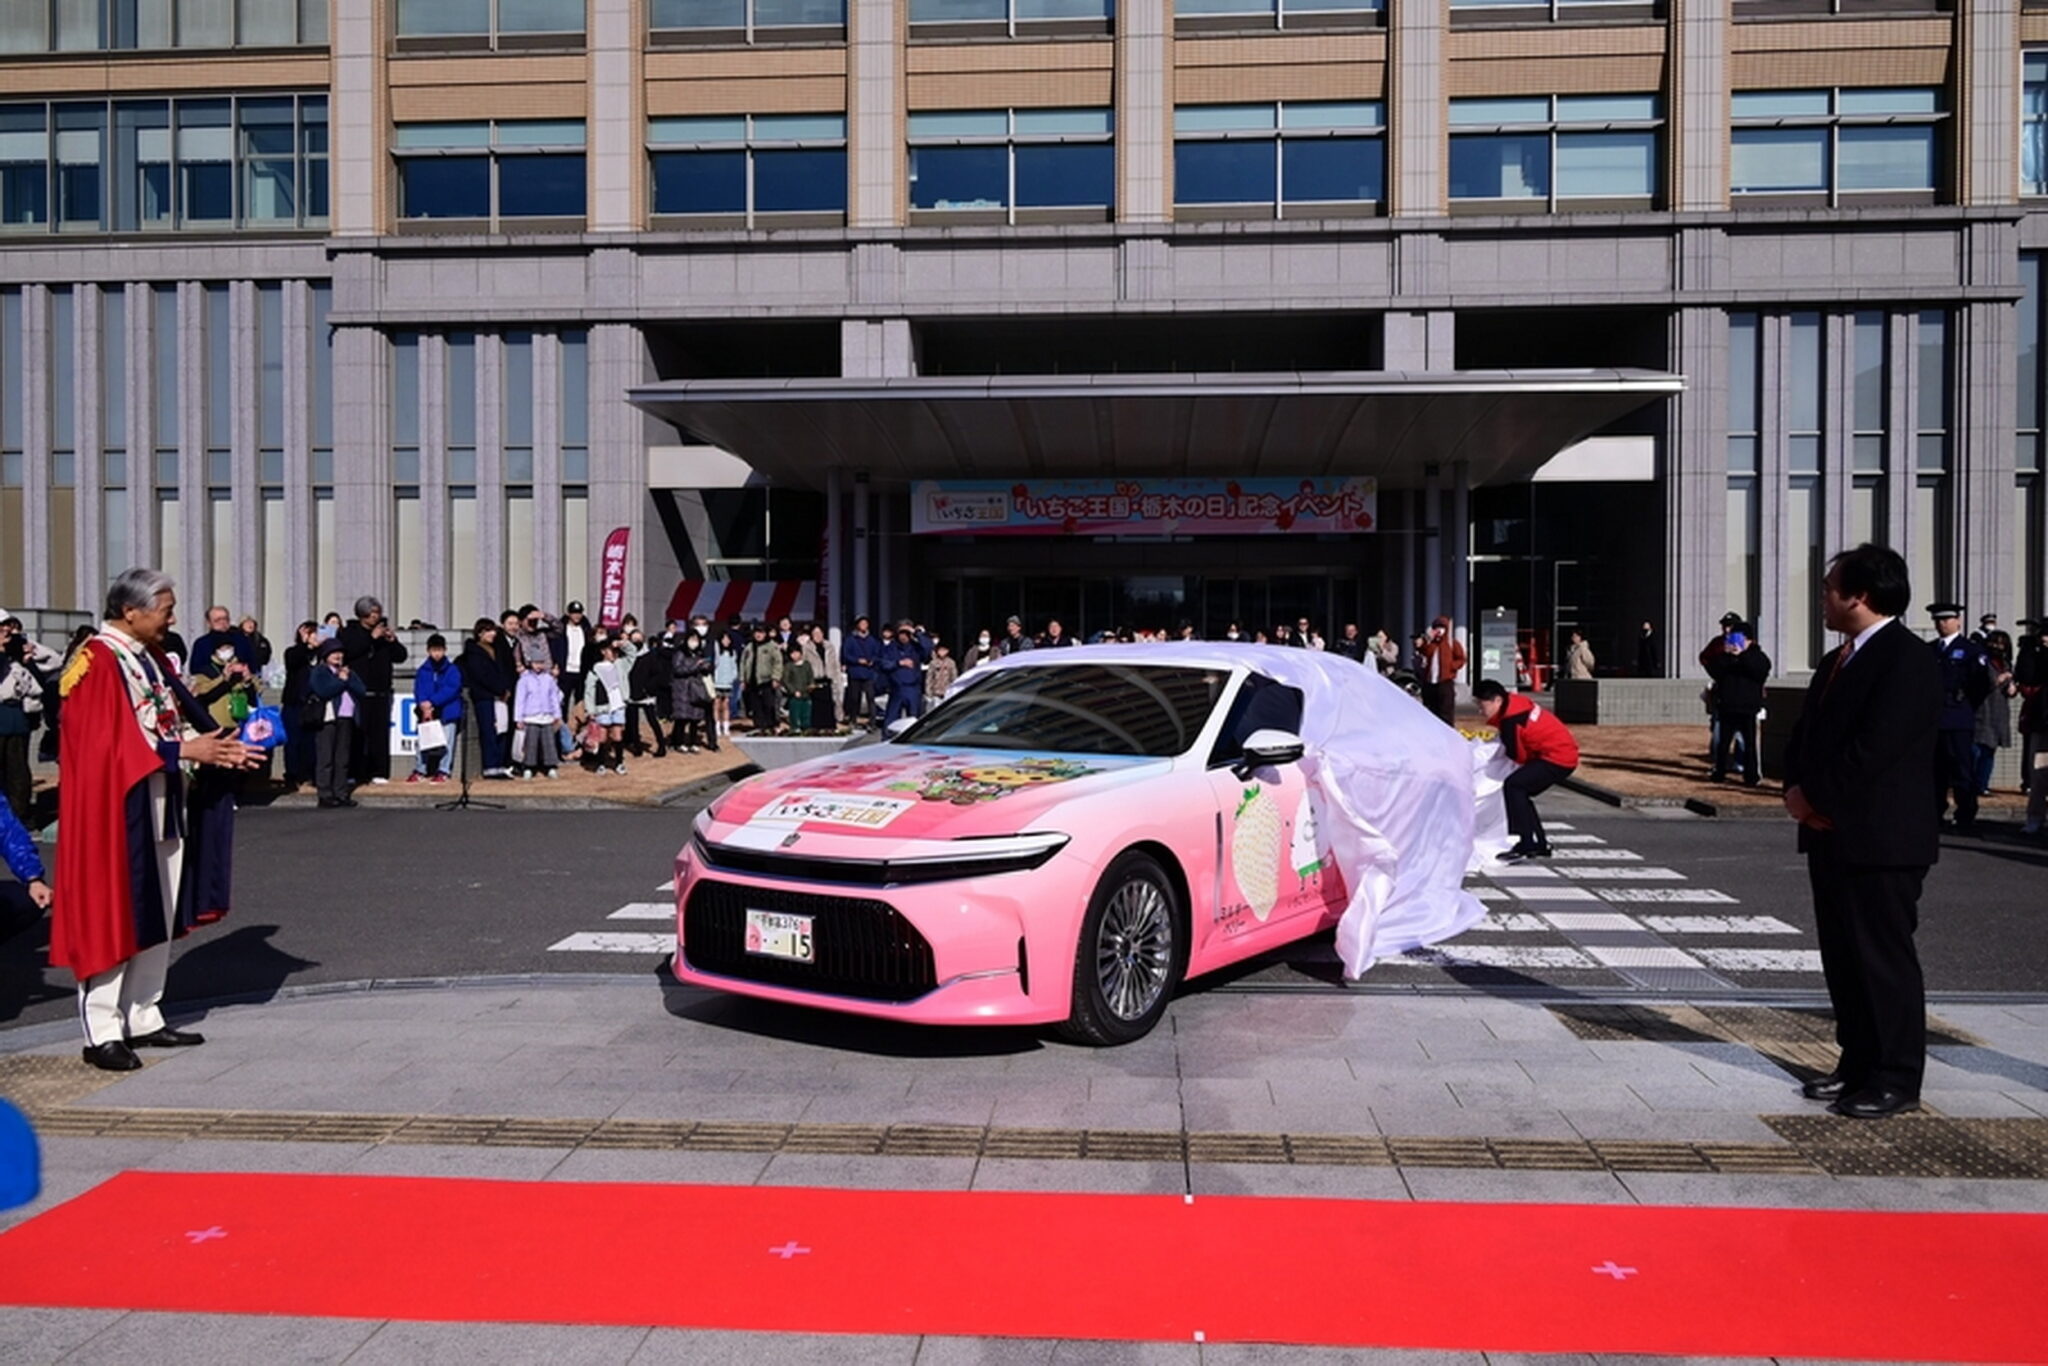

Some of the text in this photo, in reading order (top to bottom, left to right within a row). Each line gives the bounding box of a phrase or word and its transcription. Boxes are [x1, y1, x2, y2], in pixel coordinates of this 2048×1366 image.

[1014, 495, 1364, 519] 「いちご王国・栃木の日」記念イベント
